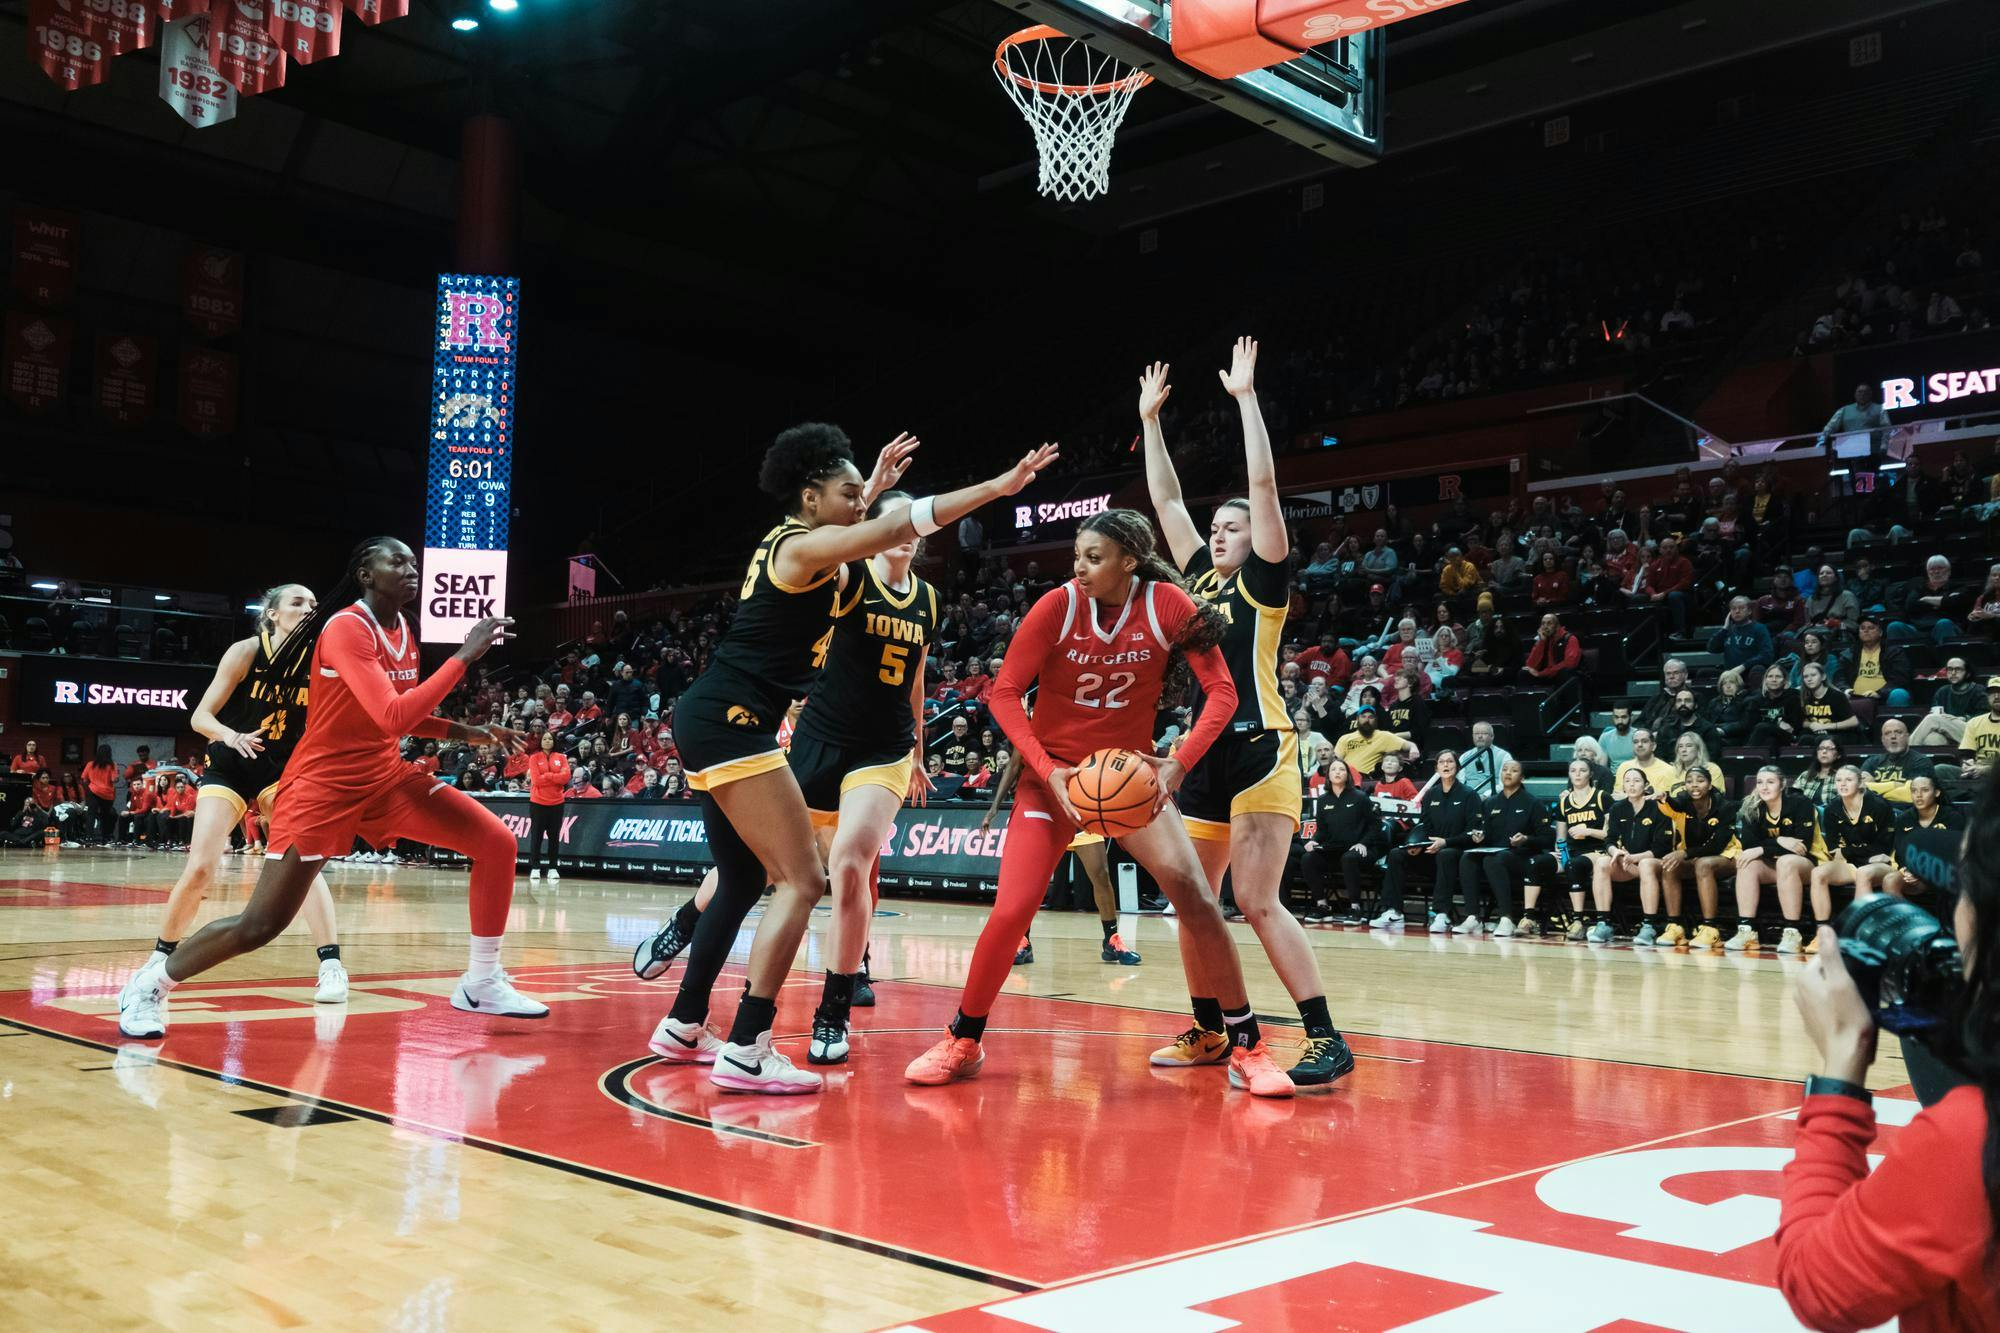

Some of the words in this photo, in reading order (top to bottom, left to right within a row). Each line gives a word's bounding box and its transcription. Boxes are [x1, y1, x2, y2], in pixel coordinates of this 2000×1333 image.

[272, 0, 334, 32] 1989
[35, 26, 102, 61] 1986
[108, 29, 120, 44] R
[217, 32, 278, 66] 1987
[296, 38, 310, 54] R
[44, 50, 66, 64] ELITE
[184, 55, 208, 66] WOME
[224, 56, 244, 68] ELITE
[64, 66, 76, 80] R
[240, 71, 253, 85] R
[168, 67, 228, 100] 1982
[175, 90, 221, 108] CHAMPIONS
[192, 105, 205, 118] R
[457, 278, 469, 286] PT
[475, 279, 482, 287] R
[491, 280, 498, 288] A
[445, 290, 450, 298] 2
[461, 291, 466, 299] 0
[507, 293, 512, 301] 0
[442, 303, 452, 311] 12
[460, 304, 465, 312] 0
[476, 305, 481, 313] 0
[506, 306, 511, 314] 0
[441, 316, 452, 324] 22
[460, 317, 465, 325] 2
[491, 318, 496, 326] 0
[506, 319, 511, 327] 0
[446, 293, 508, 347] R
[441, 329, 451, 337] 30
[459, 330, 464, 338] 0
[490, 331, 495, 339] 0
[505, 332, 510, 340] 0
[440, 342, 450, 350] 32
[504, 345, 510, 353] 0
[453, 369, 465, 377] PT
[472, 370, 478, 378] R
[442, 379, 446, 387] 1
[456, 380, 461, 388] 0
[471, 381, 477, 389] 0
[502, 382, 507, 390] 0
[440, 392, 445, 400] 4
[455, 393, 460, 401] 0
[1881, 378, 1920, 410] R
[440, 405, 445, 413] 5
[437, 418, 447, 426] 11
[454, 419, 459, 427] 0
[470, 420, 475, 428] 0
[500, 421, 505, 429] 0
[454, 432, 458, 440] 1
[469, 433, 474, 441] 4
[450, 460, 492, 479] 6:01
[442, 480, 457, 489] RU
[478, 481, 505, 491] IOWA
[1438, 474, 1462, 500] R
[443, 491, 453, 505] 2
[485, 493, 495, 506] 9
[1015, 506, 1032, 530] R
[1038, 493, 1112, 524] SEATGEEK
[1282, 502, 1332, 521] Horizon
[740, 548, 768, 600] 5
[434, 573, 495, 595] SEAT
[429, 597, 496, 619] GEEK
[865, 612, 924, 646] IOWA
[878, 643, 910, 686] 5
[1066, 648, 1152, 666] RUTGERS
[54, 680, 82, 704] R
[88, 683, 188, 710] SEATGEEK
[1074, 672, 1136, 709] 22
[1567, 810, 1596, 824] IOWA
[610, 818, 666, 841] OFFICIAL
[666, 820, 708, 843] TICKE
[1301, 822, 1318, 839] R
